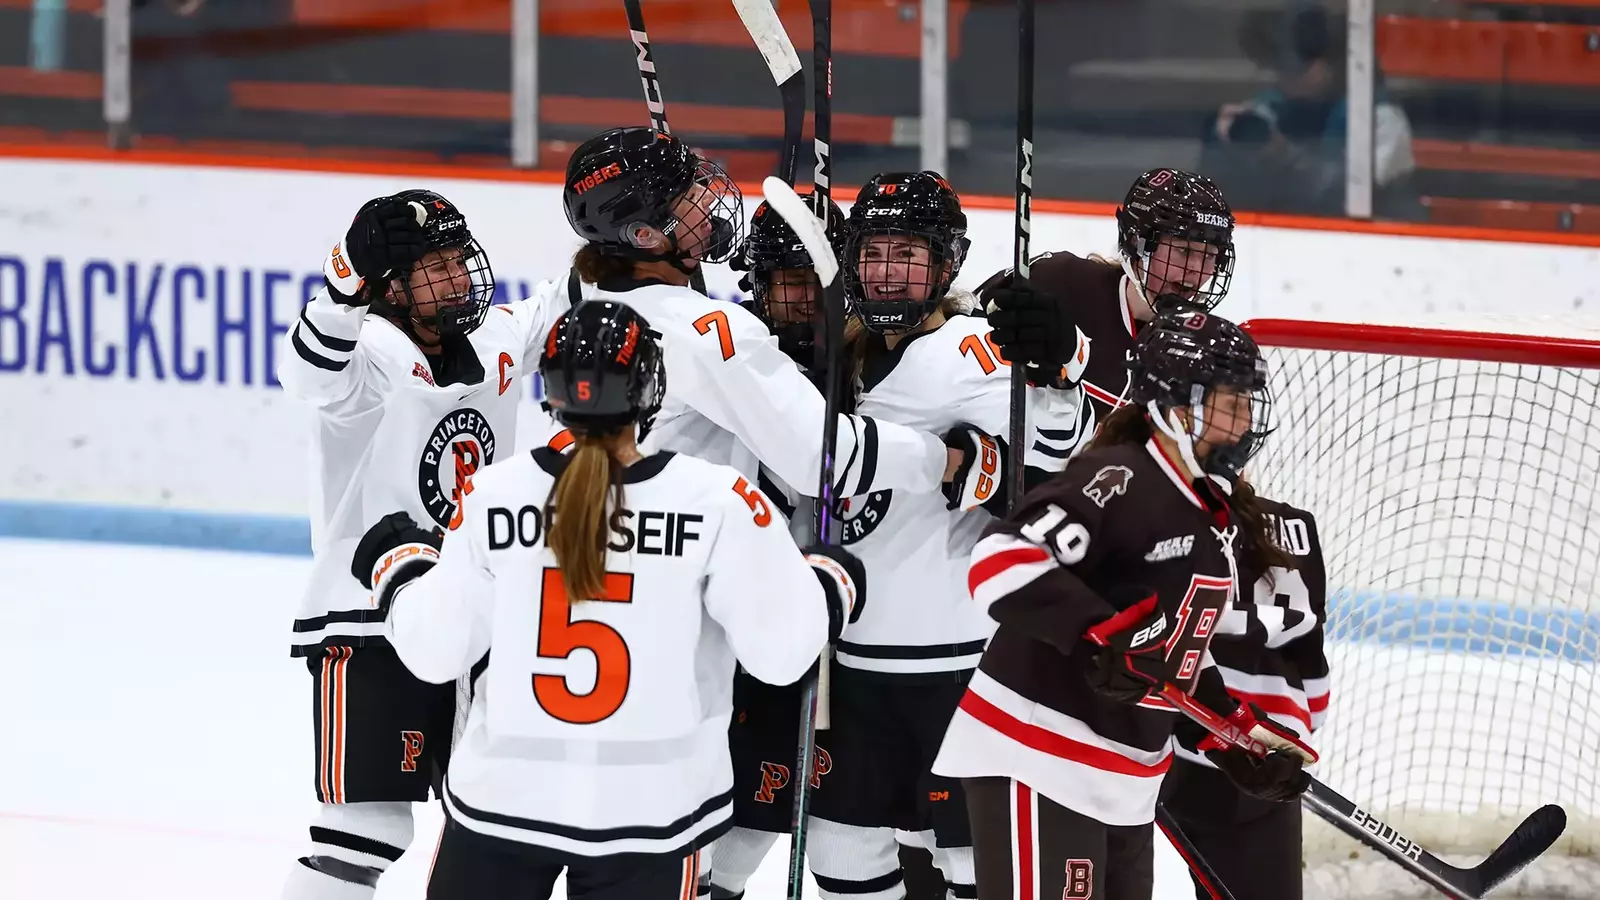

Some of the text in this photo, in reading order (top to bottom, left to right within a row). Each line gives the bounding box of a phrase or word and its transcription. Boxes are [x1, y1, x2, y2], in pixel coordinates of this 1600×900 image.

[573, 162, 623, 196] TIGERS
[1149, 170, 1172, 187] B
[438, 218, 464, 231] CCM
[866, 207, 903, 218] CCM
[1019, 138, 1033, 280] CCM
[1196, 210, 1230, 229] BEARS
[0, 254, 324, 389] BACKCHE
[692, 310, 736, 363] 7
[1184, 313, 1207, 330] B
[498, 351, 515, 397] C
[577, 381, 590, 401] 5
[424, 412, 495, 467] PRINCETON
[732, 476, 773, 529] 5
[487, 504, 704, 557] DOSEIF
[1020, 503, 1092, 566] 19
[531, 566, 635, 725] 5
[401, 730, 425, 772] P
[754, 761, 791, 804] P
[1351, 806, 1424, 862] BAUER
[1062, 858, 1094, 900] B
